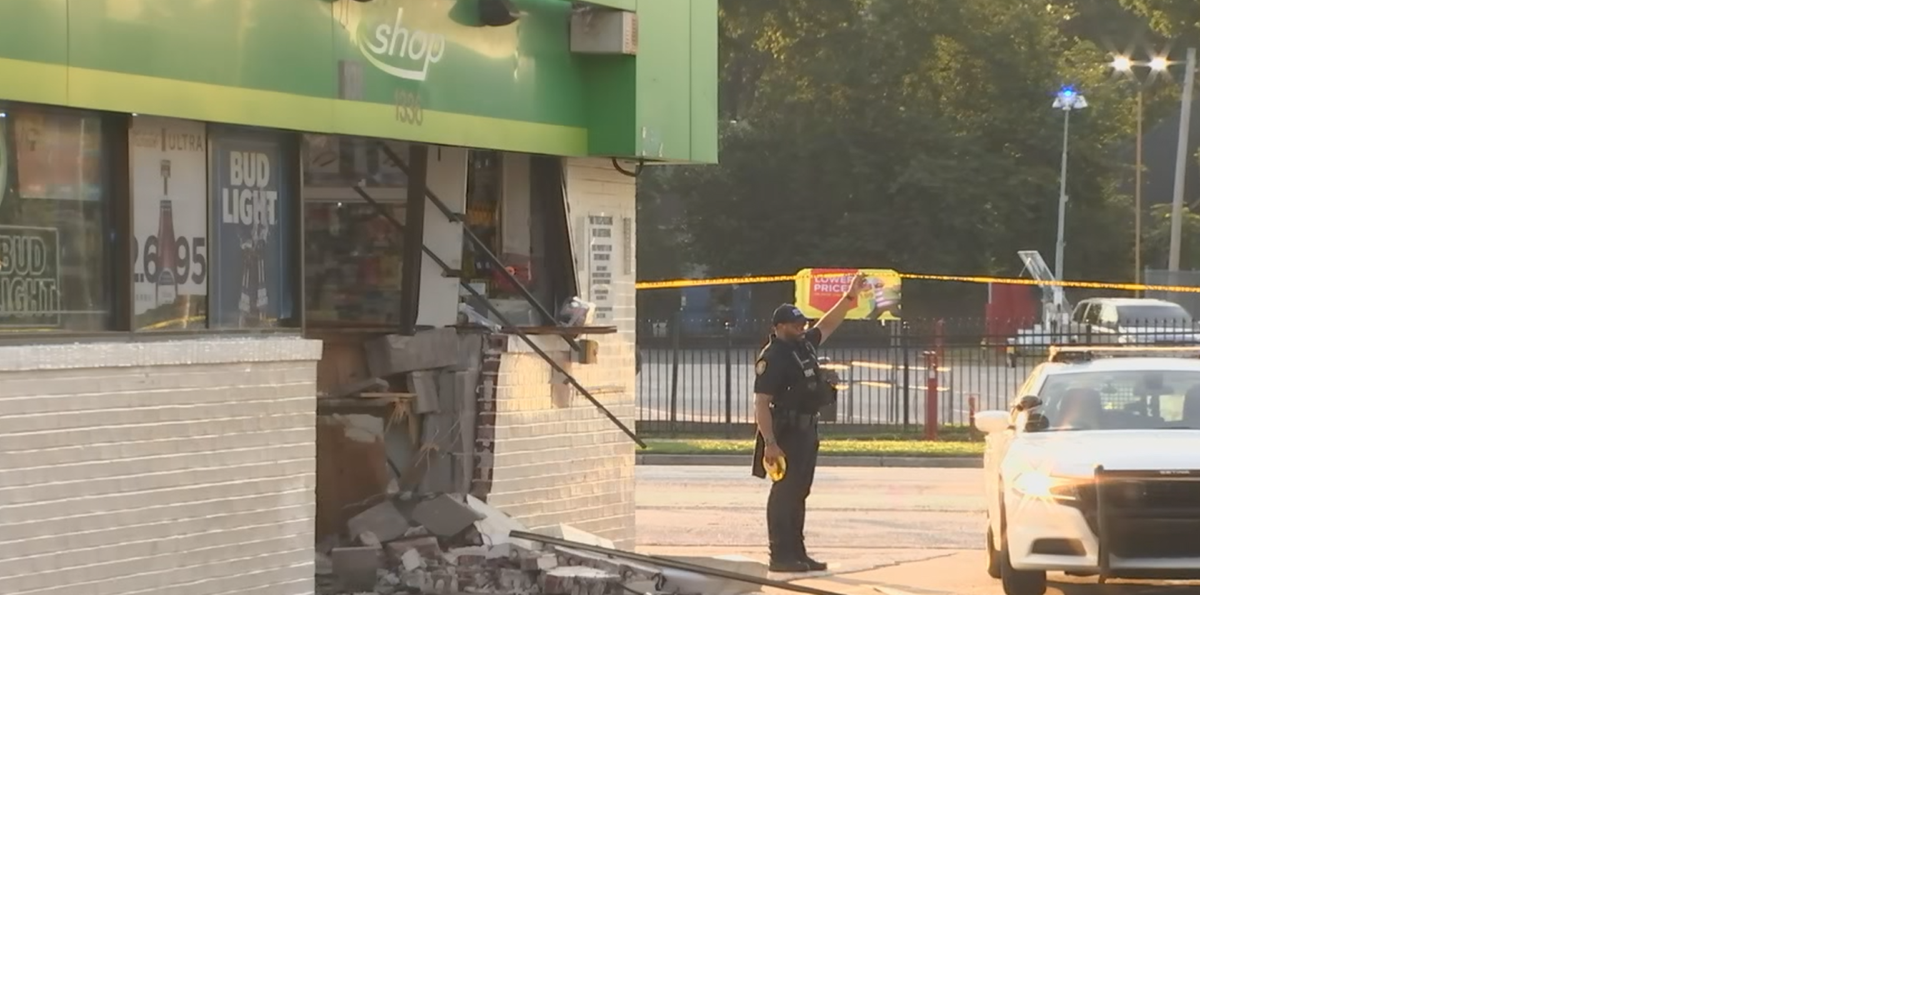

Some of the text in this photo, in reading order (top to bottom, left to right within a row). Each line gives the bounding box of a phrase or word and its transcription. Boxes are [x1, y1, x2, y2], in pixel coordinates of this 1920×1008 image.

[360, 7, 445, 81] shop
[168, 133, 204, 152] ULTRA
[229, 150, 270, 188] BUD
[222, 187, 278, 226] LIGHT
[0, 235, 46, 275] BUD
[0, 277, 56, 317] IGHT
